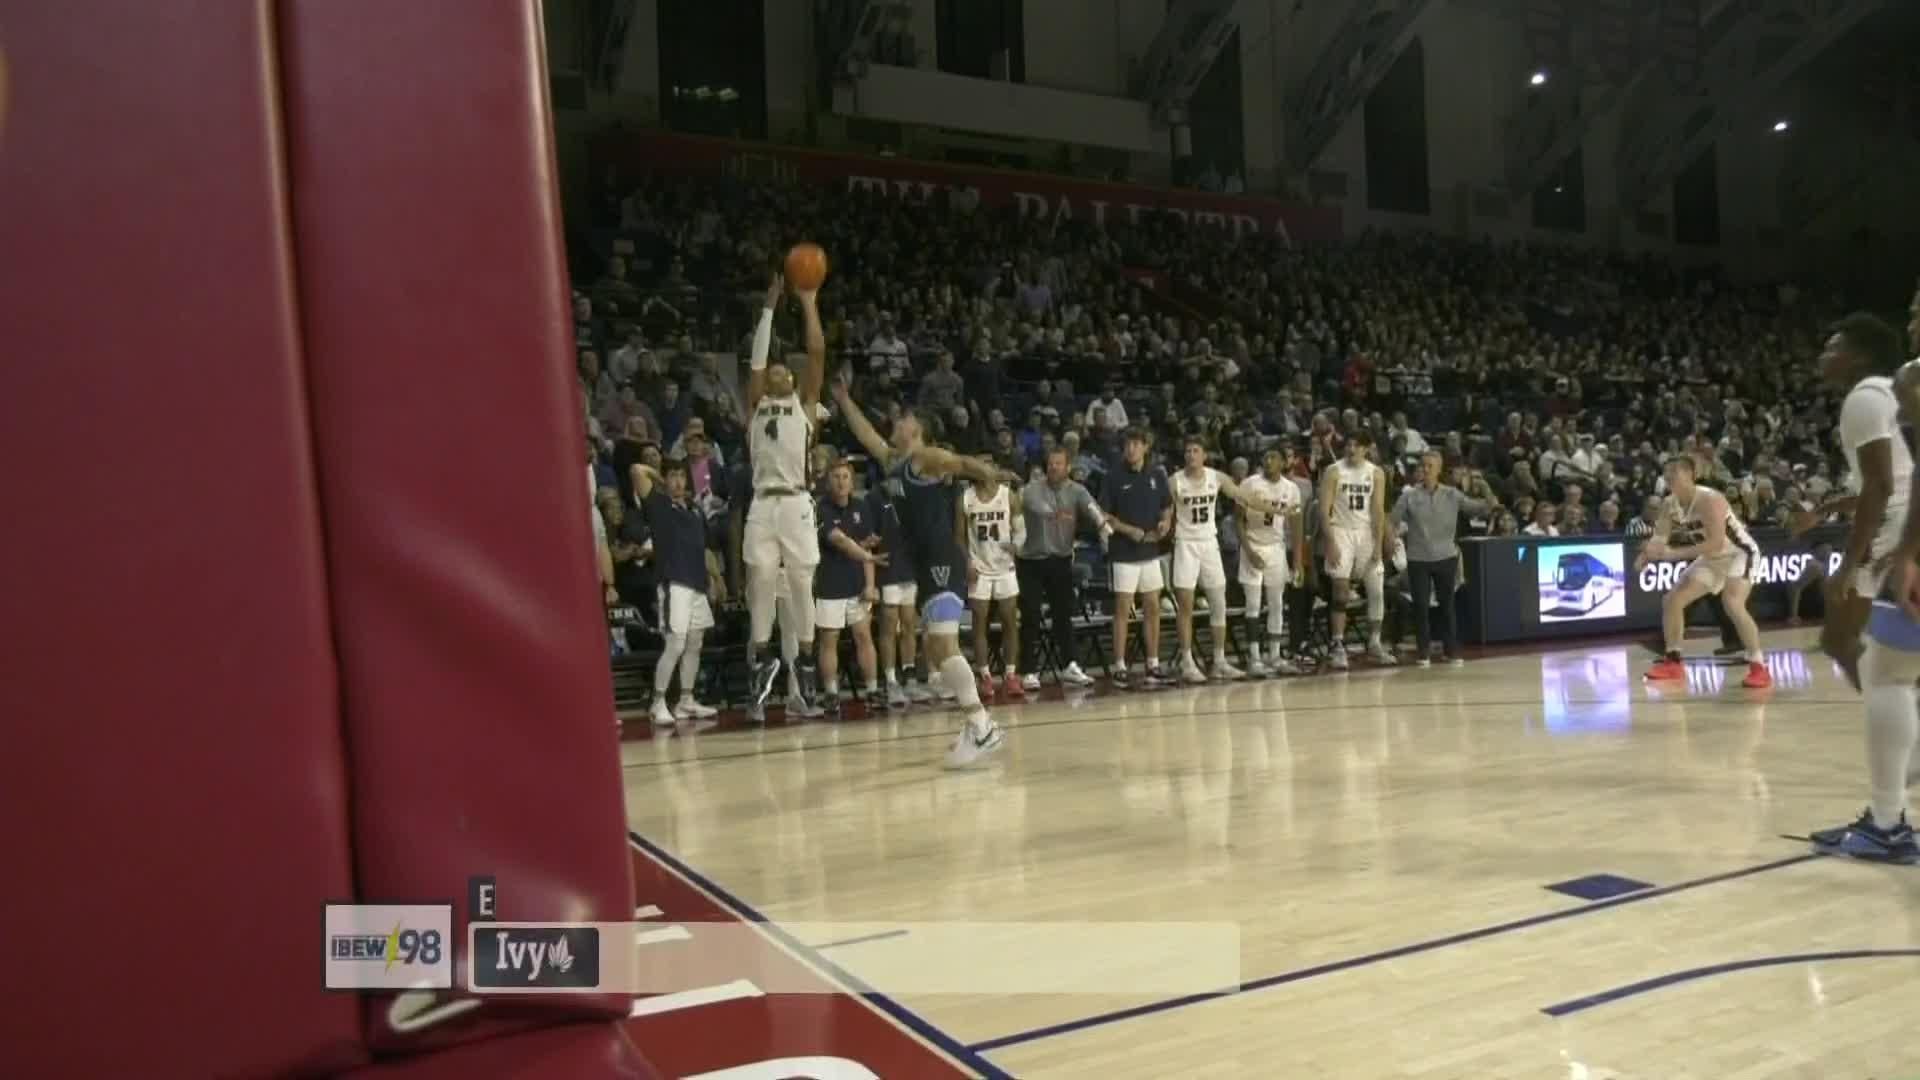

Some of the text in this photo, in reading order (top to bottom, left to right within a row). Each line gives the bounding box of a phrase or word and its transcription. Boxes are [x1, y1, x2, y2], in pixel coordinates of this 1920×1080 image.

[764, 418, 779, 441] 4
[1191, 506, 1209, 524] 15
[977, 523, 1000, 541] 24
